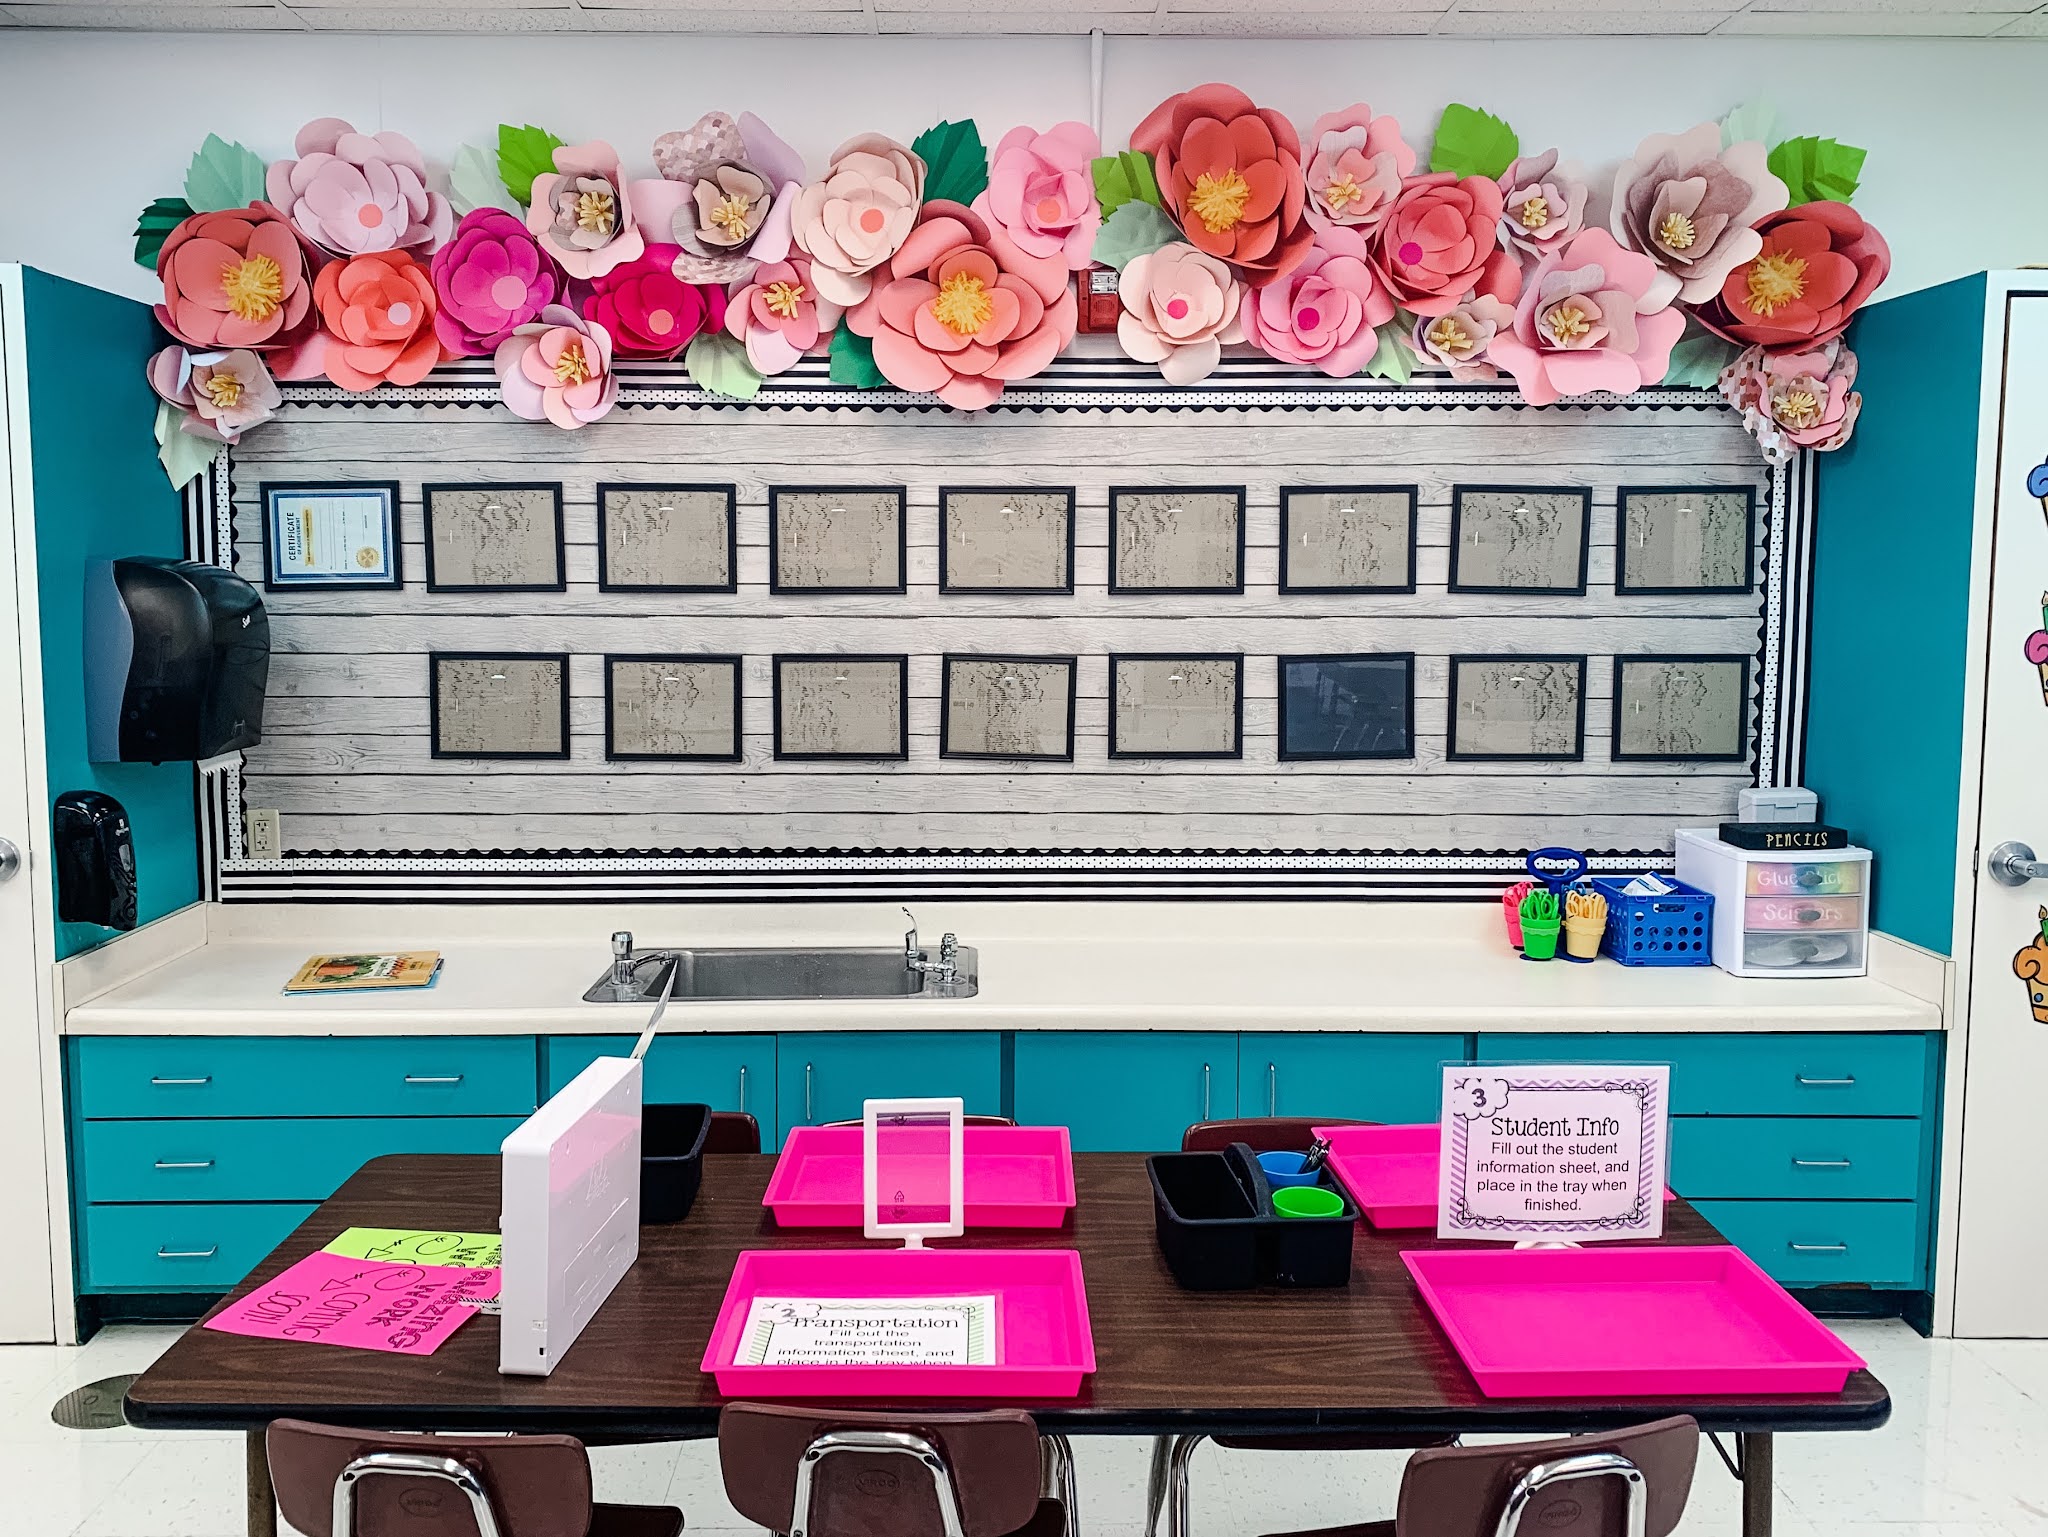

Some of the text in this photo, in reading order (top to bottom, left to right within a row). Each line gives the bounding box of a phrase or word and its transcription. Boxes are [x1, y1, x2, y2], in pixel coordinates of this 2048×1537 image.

[287, 512, 296, 561] CERTIFICATE
[1765, 832, 1828, 848] PENCILS
[1757, 870, 1799, 886] Glue
[1472, 1088, 1487, 1108] 3
[1491, 1117, 1619, 1137] Student Info
[1491, 1142, 1618, 1155] Fill out the student
[1477, 1160, 1629, 1175] information sheet, and
[1477, 1179, 1627, 1195] place in the tray when
[1524, 1199, 1582, 1211] finished.
[240, 1290, 310, 1326] SOON!
[365, 1282, 447, 1328] WORK
[781, 1308, 797, 1318] 2
[282, 1292, 371, 1339] COMING
[791, 1317, 959, 1329] Transportation
[829, 1329, 852, 1337] Fill
[885, 1329, 910, 1337] the
[814, 1339, 921, 1348] transportation
[778, 1348, 955, 1358] information sheet, and
